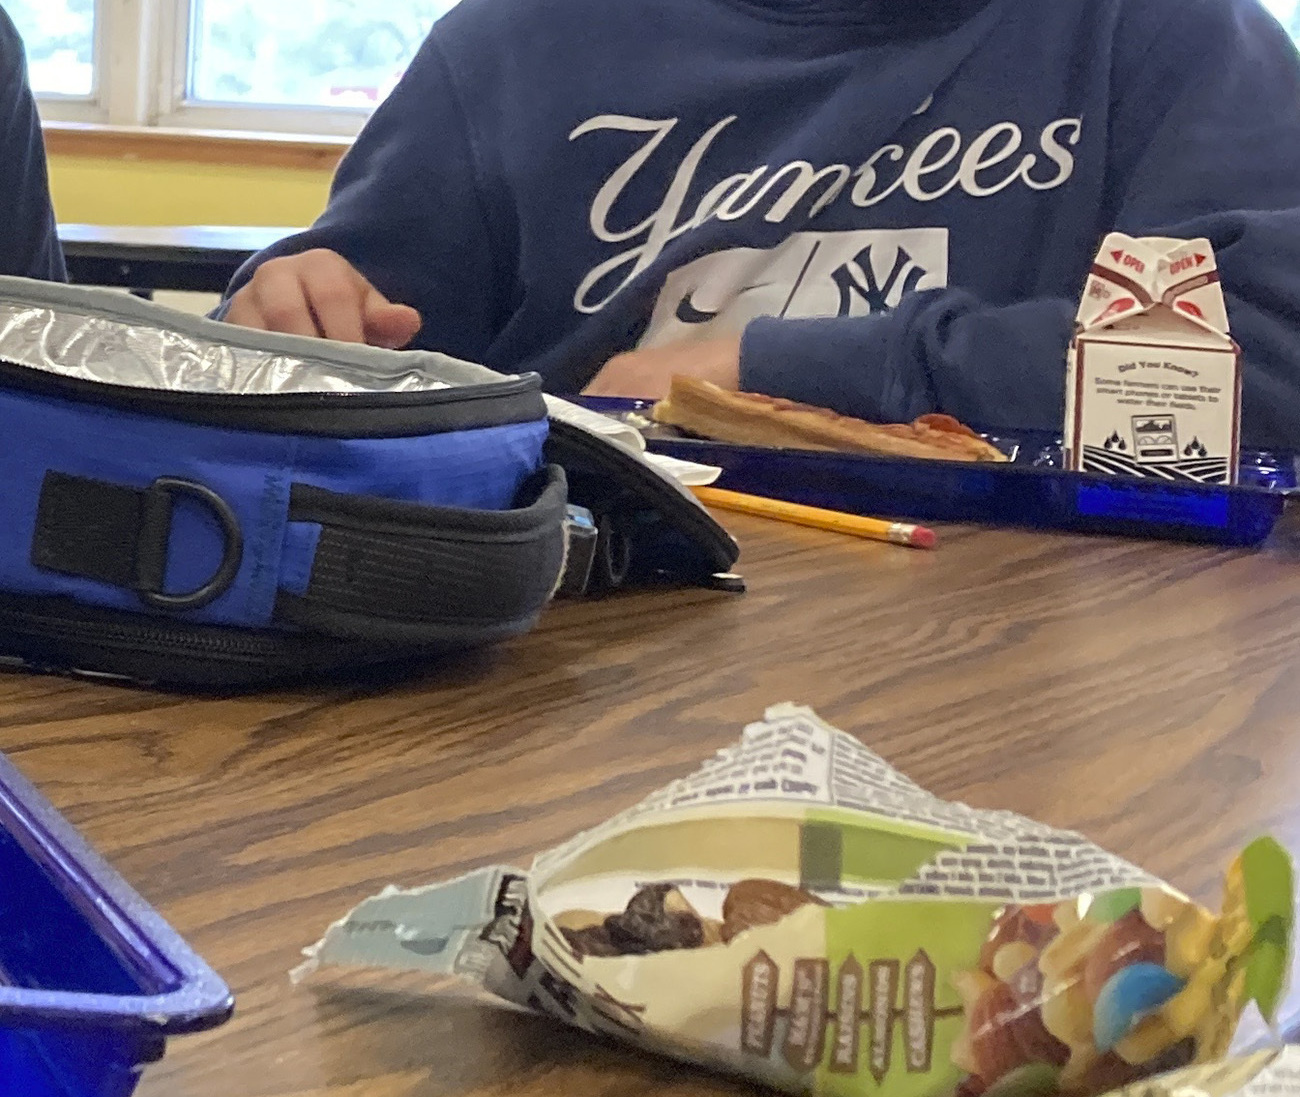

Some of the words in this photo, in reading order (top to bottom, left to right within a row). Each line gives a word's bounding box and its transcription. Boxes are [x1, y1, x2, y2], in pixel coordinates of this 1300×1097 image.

[1123, 254, 1146, 275] OPEN
[1118, 363, 1136, 373] Did
[1138, 361, 1161, 369] You
[1163, 361, 1199, 378] Know?
